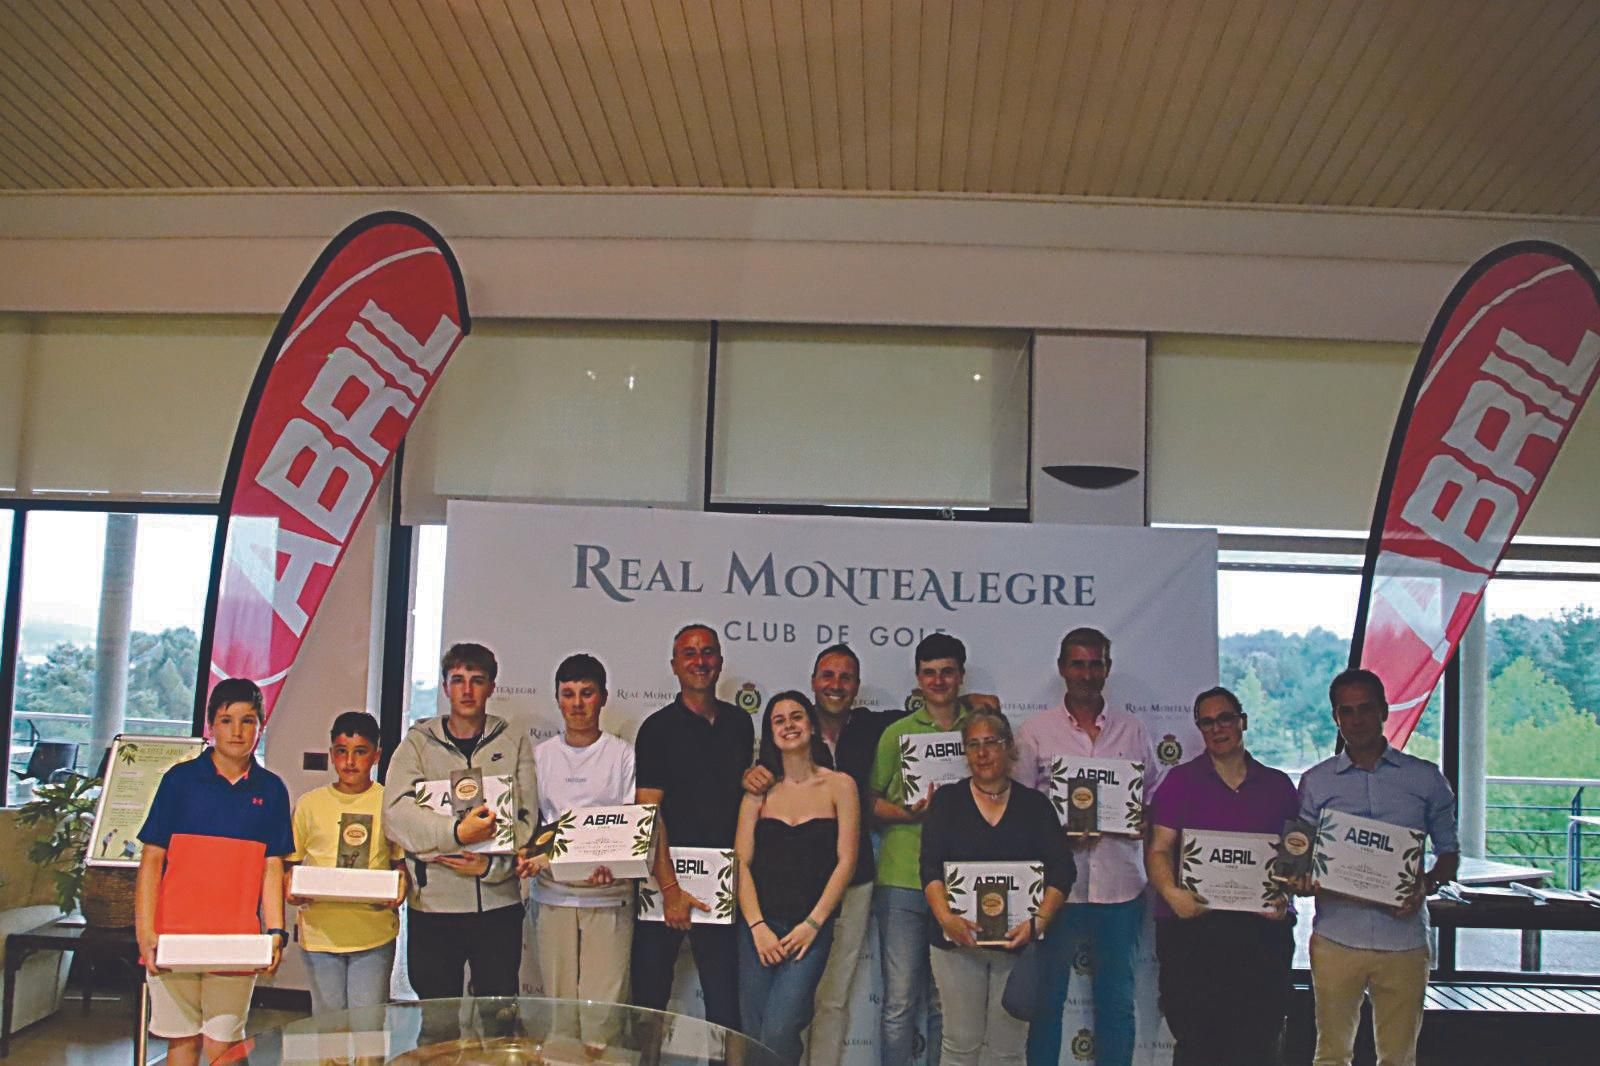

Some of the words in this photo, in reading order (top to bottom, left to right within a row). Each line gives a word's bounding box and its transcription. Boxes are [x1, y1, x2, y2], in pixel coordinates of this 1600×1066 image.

[231, 299, 462, 638] ABRIL
[1374, 327, 1600, 664] ABRIL
[572, 544, 704, 602] REAL
[722, 550, 1096, 611] MONTEALEGRE
[724, 621, 796, 643] CLUB
[817, 624, 849, 645] DE
[870, 626, 945, 646] GO
[925, 743, 966, 758] ABRIL
[1076, 768, 1120, 785] ABRIL
[583, 813, 629, 827] ABRIL
[1344, 827, 1394, 853] ABRIL
[675, 859, 709, 875] BRIL
[1209, 848, 1257, 865] ABRIL
